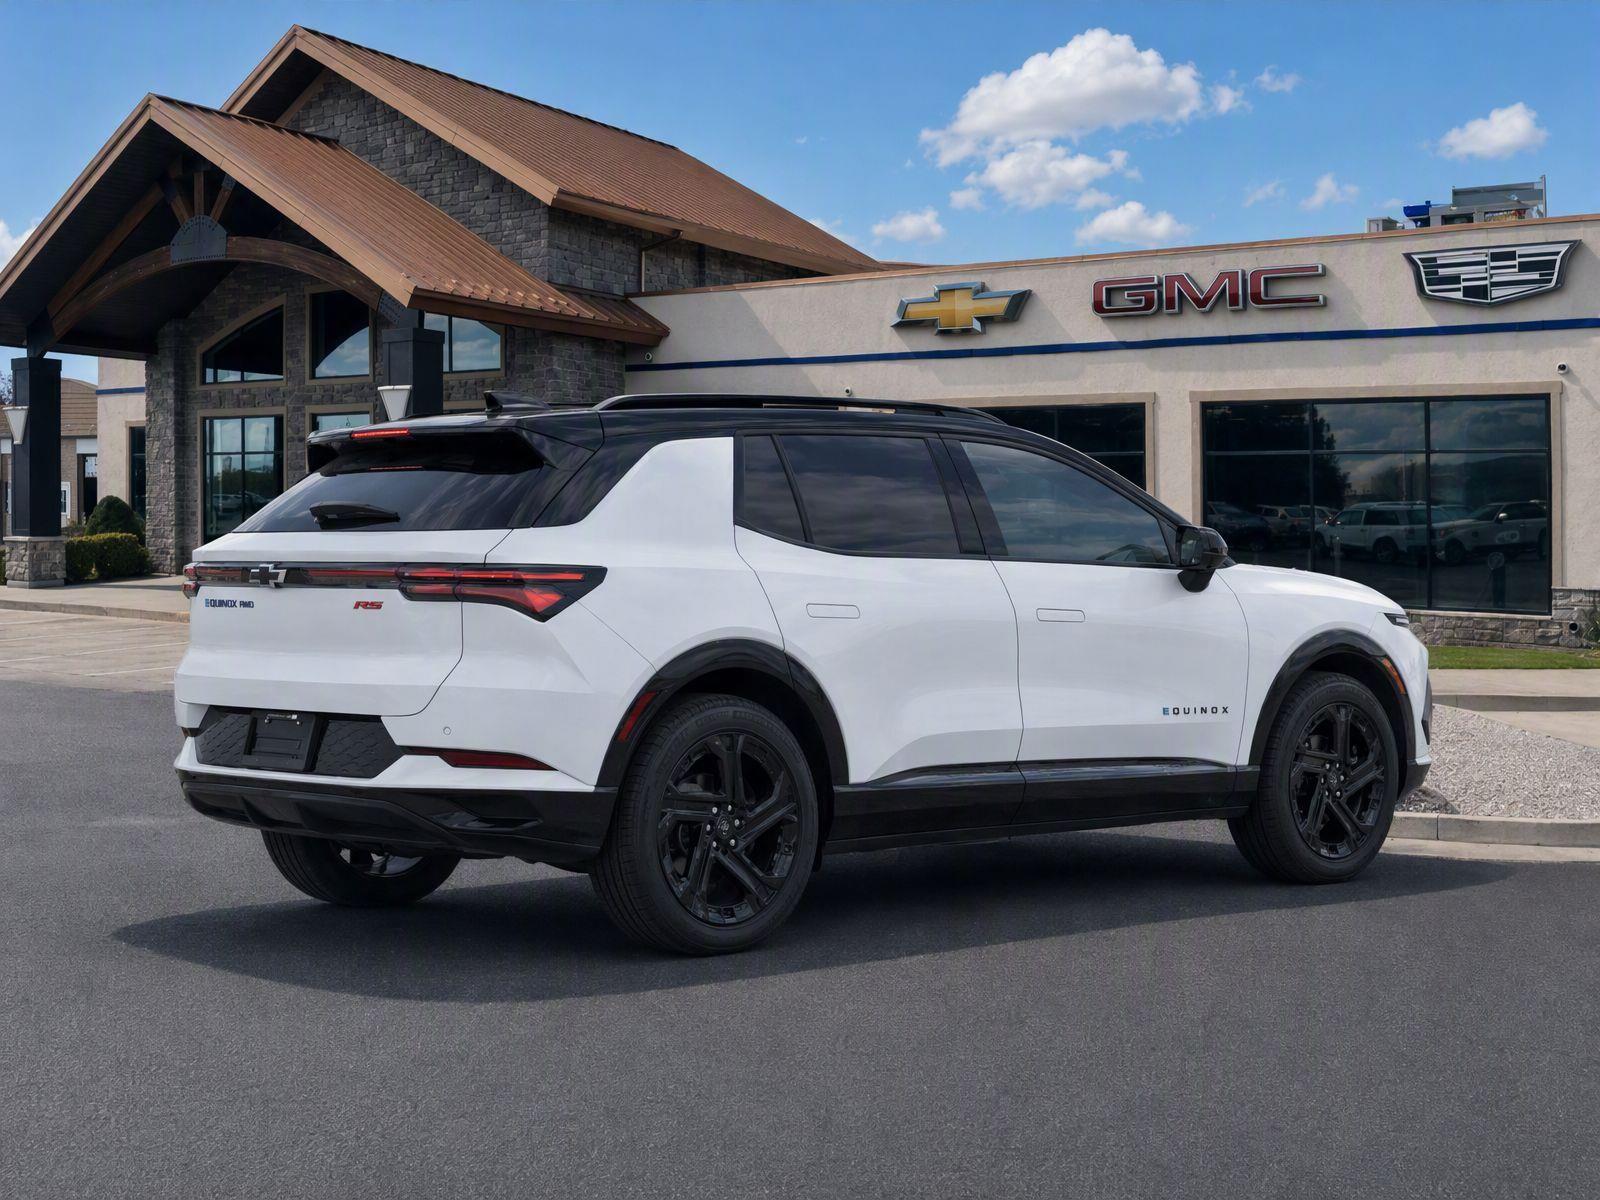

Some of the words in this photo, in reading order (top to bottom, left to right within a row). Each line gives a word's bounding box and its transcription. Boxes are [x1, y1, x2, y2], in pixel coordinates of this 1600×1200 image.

[1092, 263, 1326, 317] GMC
[205, 598, 237, 608] EQUINOX
[353, 600, 384, 610] RS
[1162, 706, 1229, 716] EQUINOX
